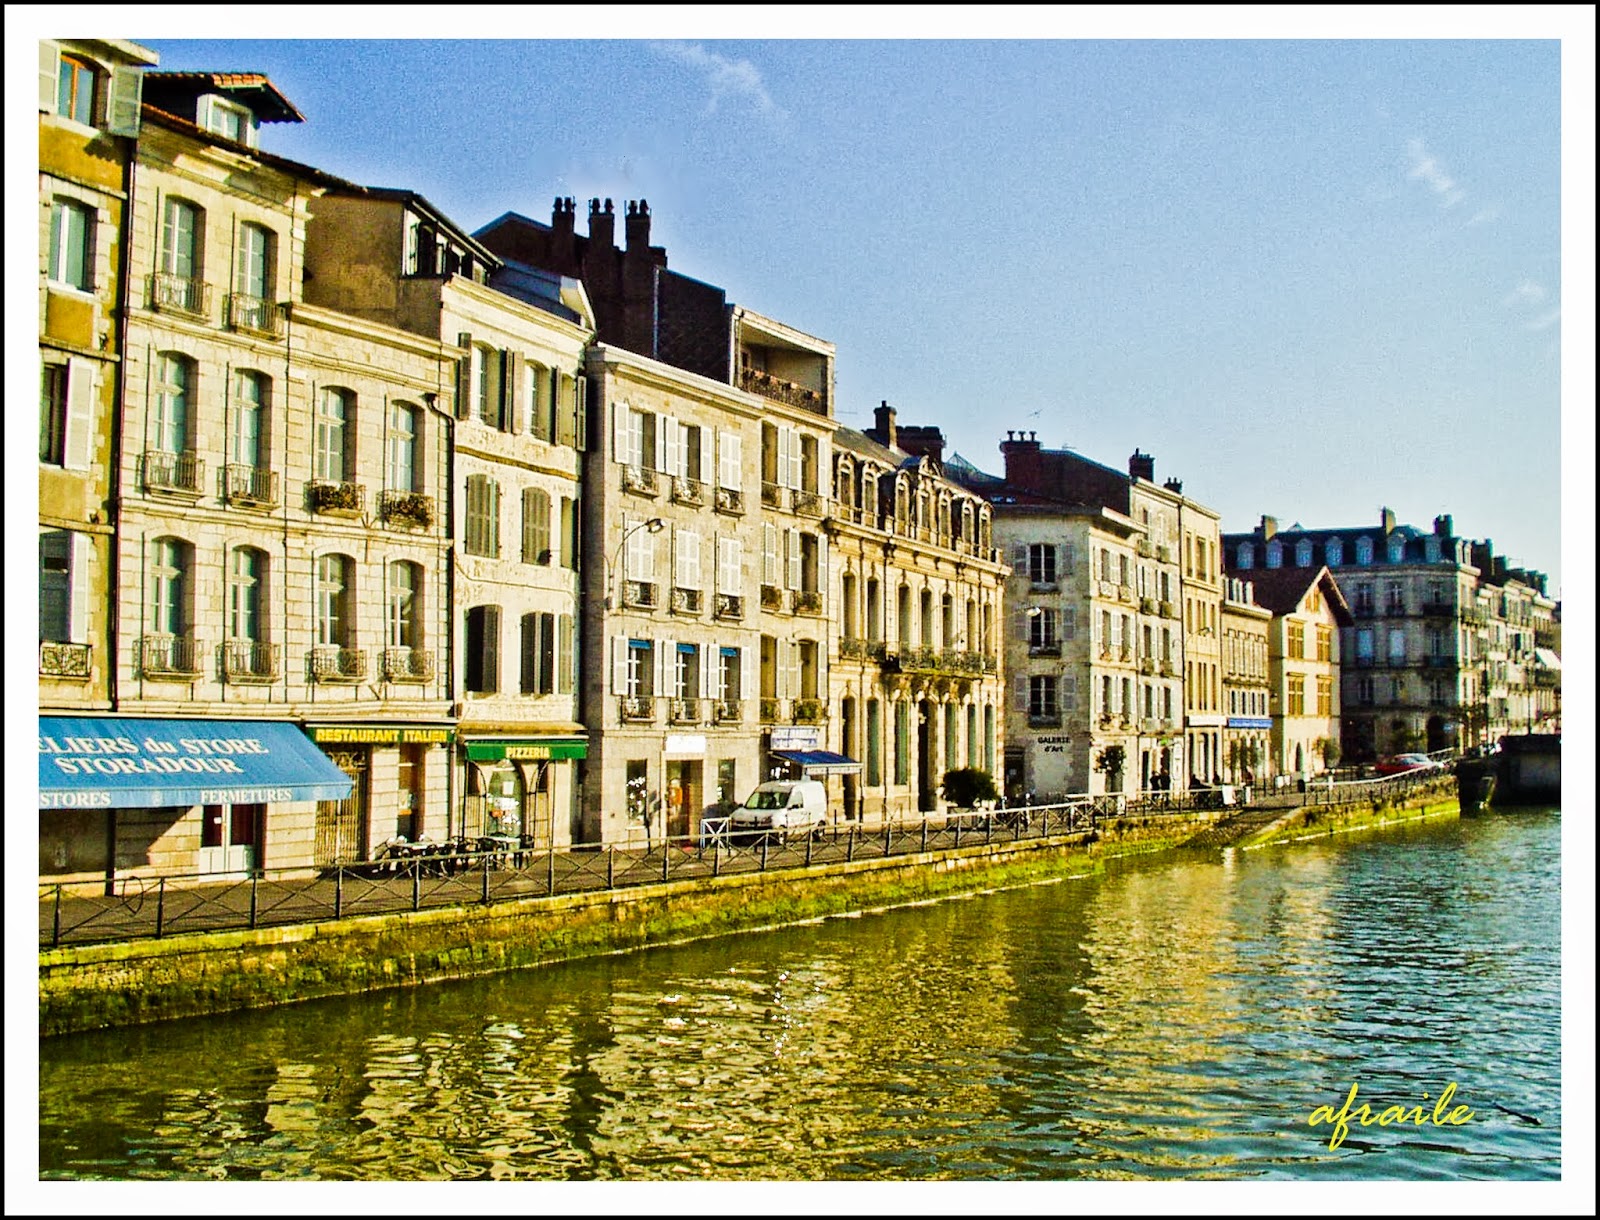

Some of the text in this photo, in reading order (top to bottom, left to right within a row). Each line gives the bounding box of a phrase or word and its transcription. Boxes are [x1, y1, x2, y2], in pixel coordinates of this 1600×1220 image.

[315, 729, 448, 743] RESTAURANT ITALIEN
[1037, 736, 1071, 744] GALERIE
[144, 738, 178, 753] du
[180, 738, 269, 755] STORE
[505, 746, 551, 759] PIZZERIA
[54, 757, 244, 774] STORADOUR
[39, 789, 293, 807] STORES FERMETURES
